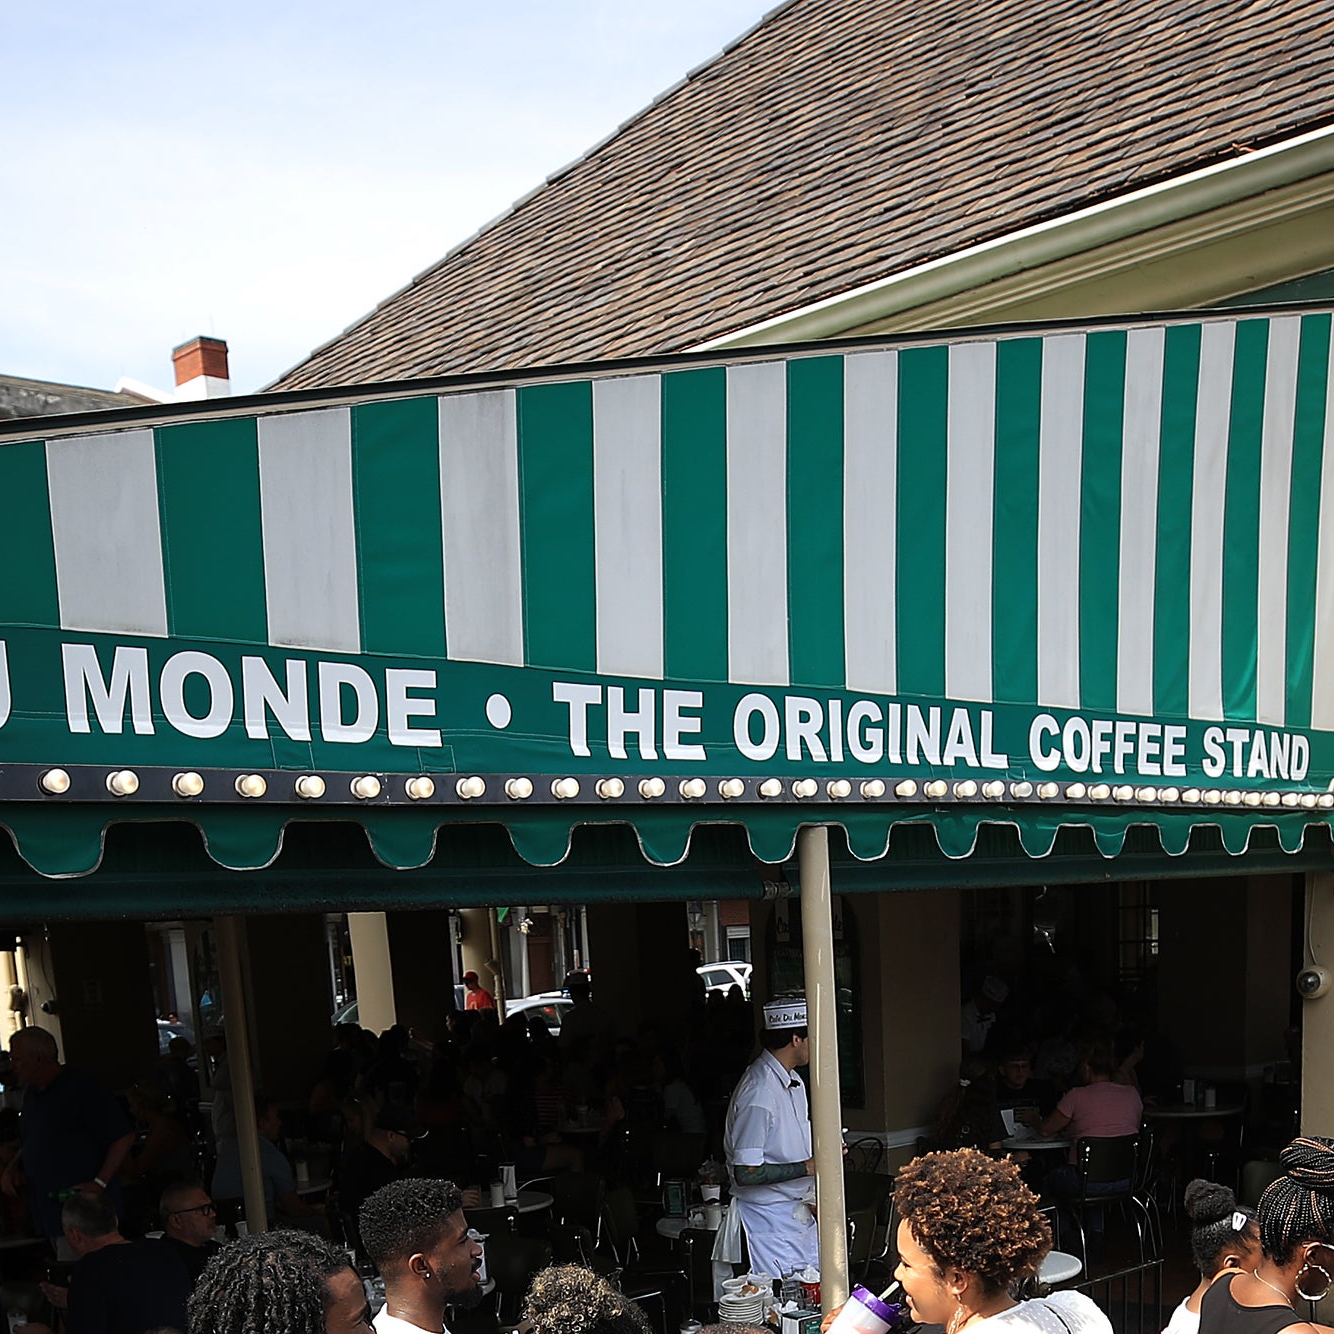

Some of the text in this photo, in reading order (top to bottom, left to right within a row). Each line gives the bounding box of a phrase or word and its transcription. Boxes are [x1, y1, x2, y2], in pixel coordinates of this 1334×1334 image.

[61, 642, 444, 747] MONDE
[552, 681, 706, 761] THE
[733, 692, 1009, 769] ORIGINAL
[1028, 713, 1188, 777] COFFEE
[1202, 726, 1311, 781] STAND
